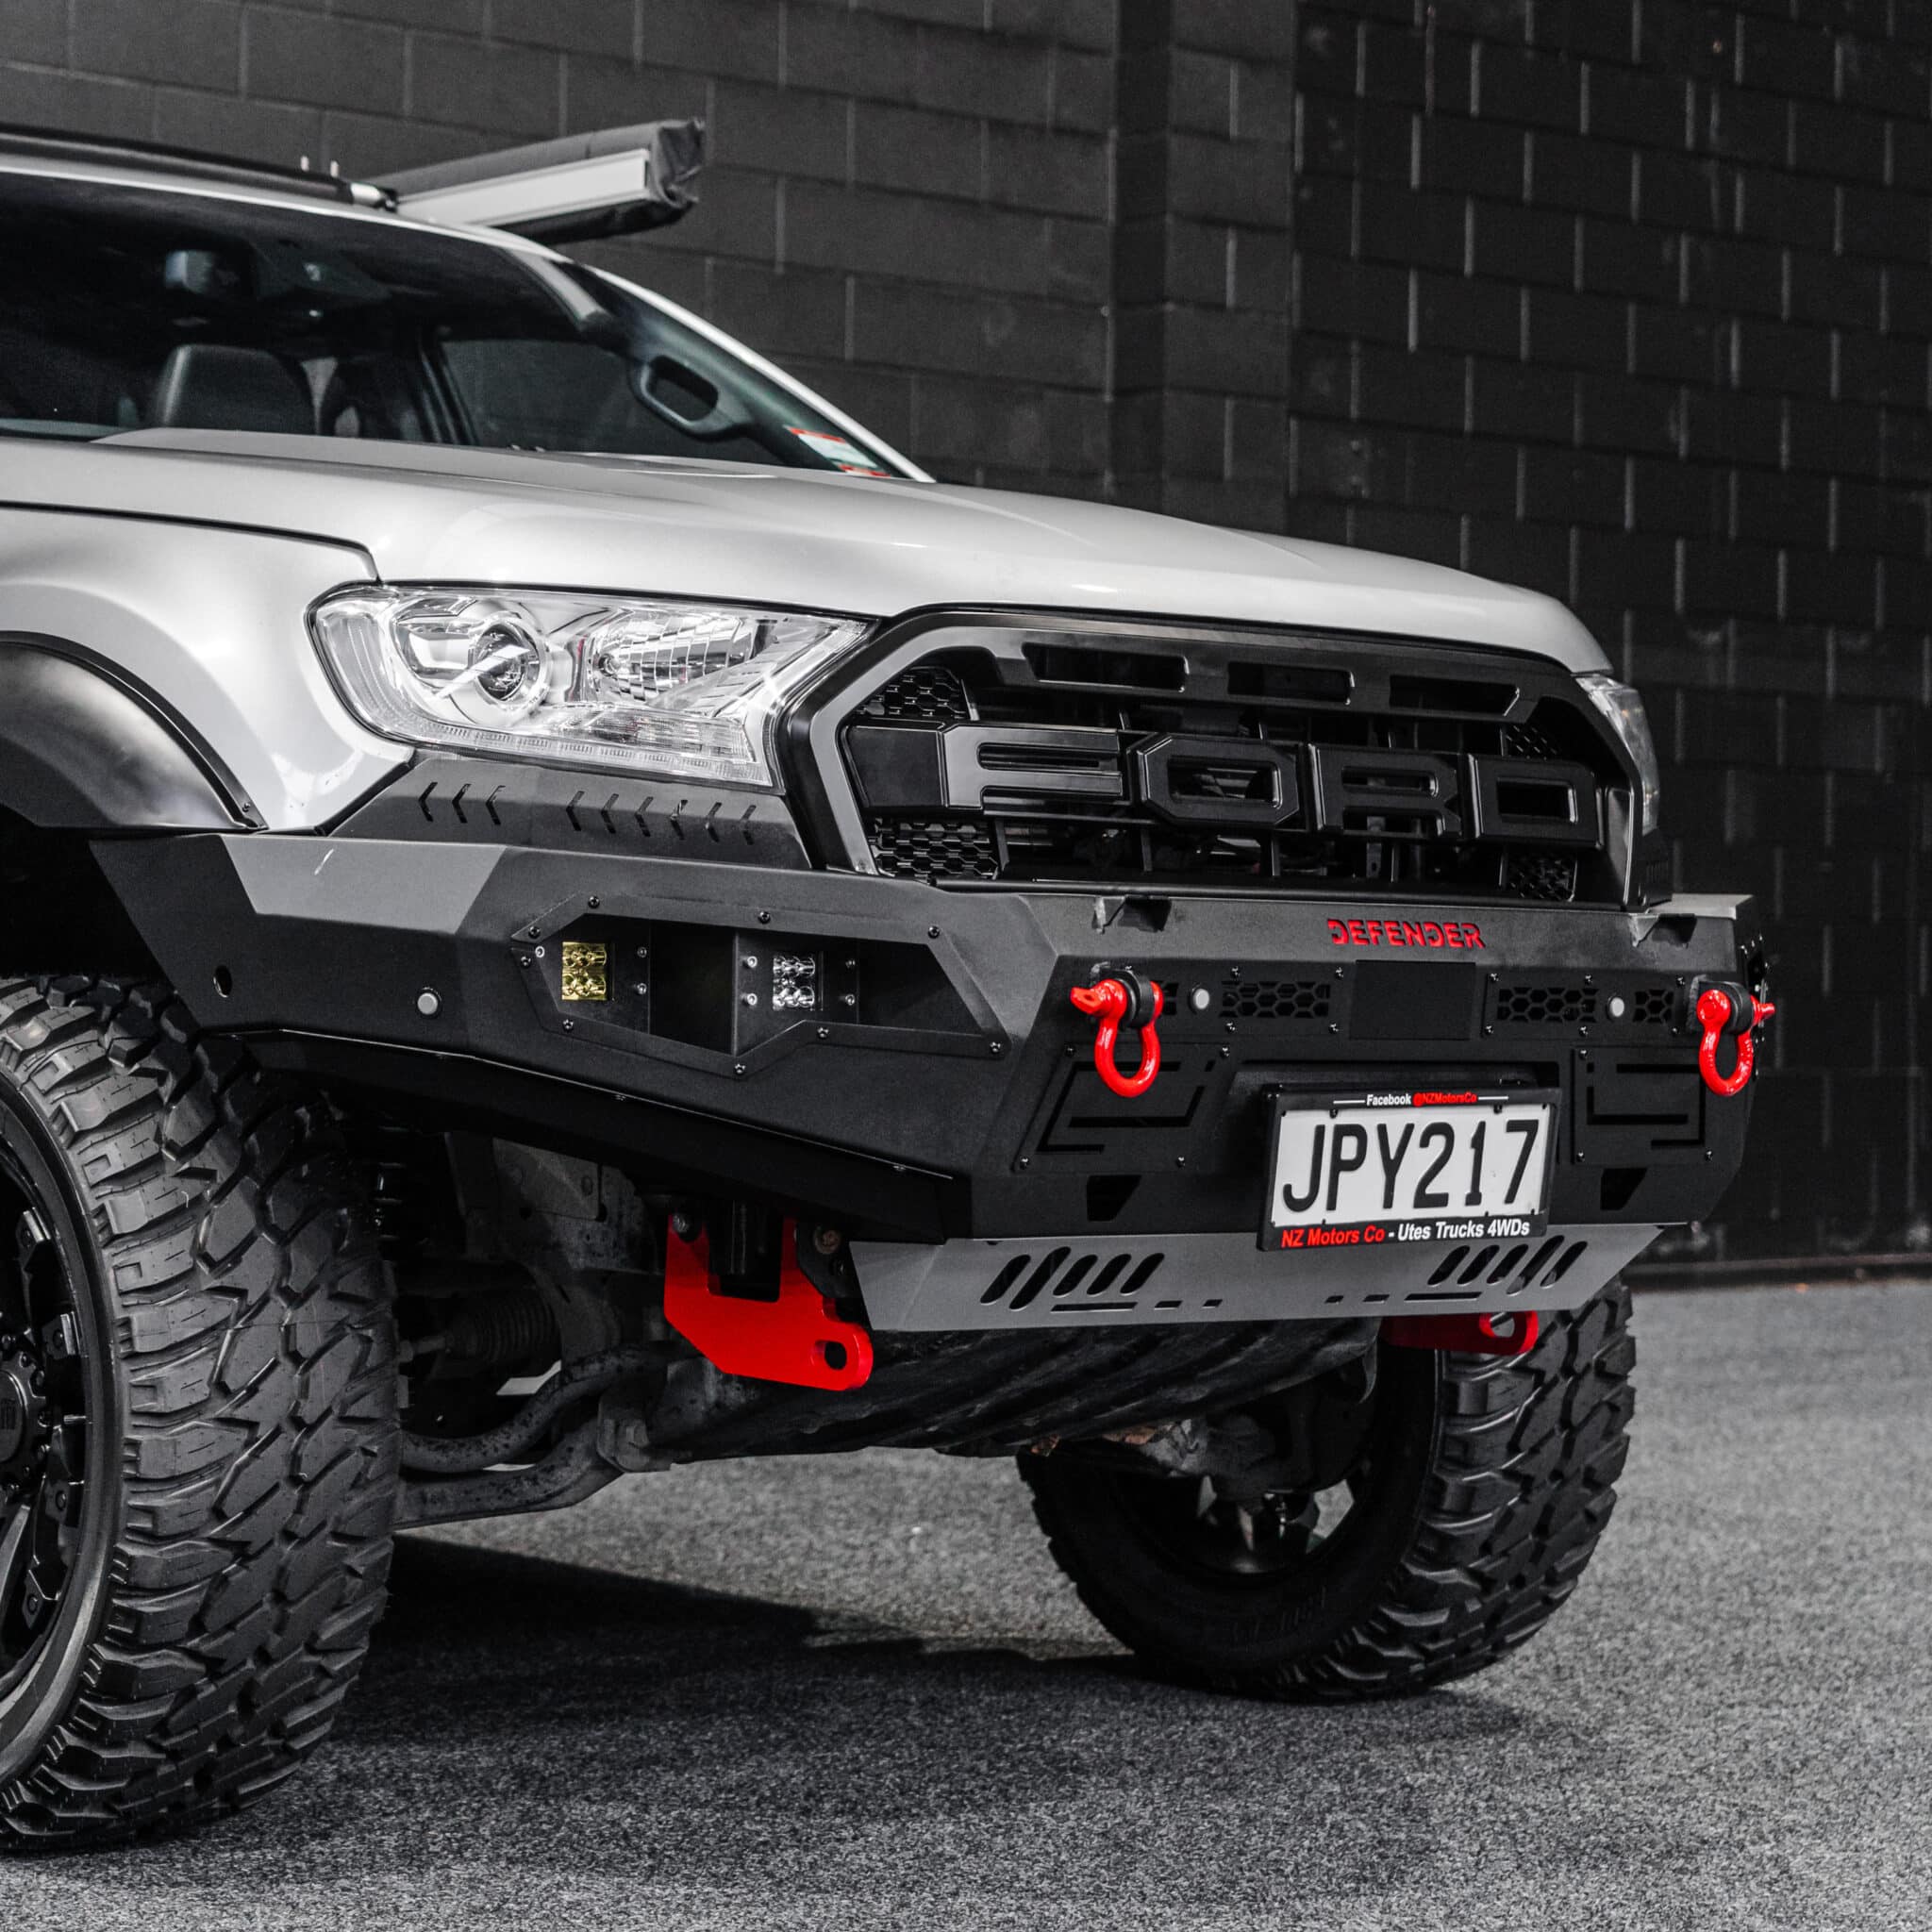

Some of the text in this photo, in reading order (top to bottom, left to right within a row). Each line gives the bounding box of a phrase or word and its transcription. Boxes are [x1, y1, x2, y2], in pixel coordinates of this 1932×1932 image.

[943, 724, 1597, 850] FORD
[1327, 919, 1485, 949] DEFENDER
[1366, 1092, 1477, 1108] Facebook @NZMotorsCo
[1282, 1119, 1540, 1212] JPY217
[1281, 1229, 1304, 1248] NZ
[1307, 1227, 1360, 1246] Motors
[1363, 1225, 1386, 1242] Co
[1398, 1223, 1431, 1241] Utes
[1434, 1221, 1484, 1239] Trucks
[1487, 1218, 1530, 1237] 4WDs
